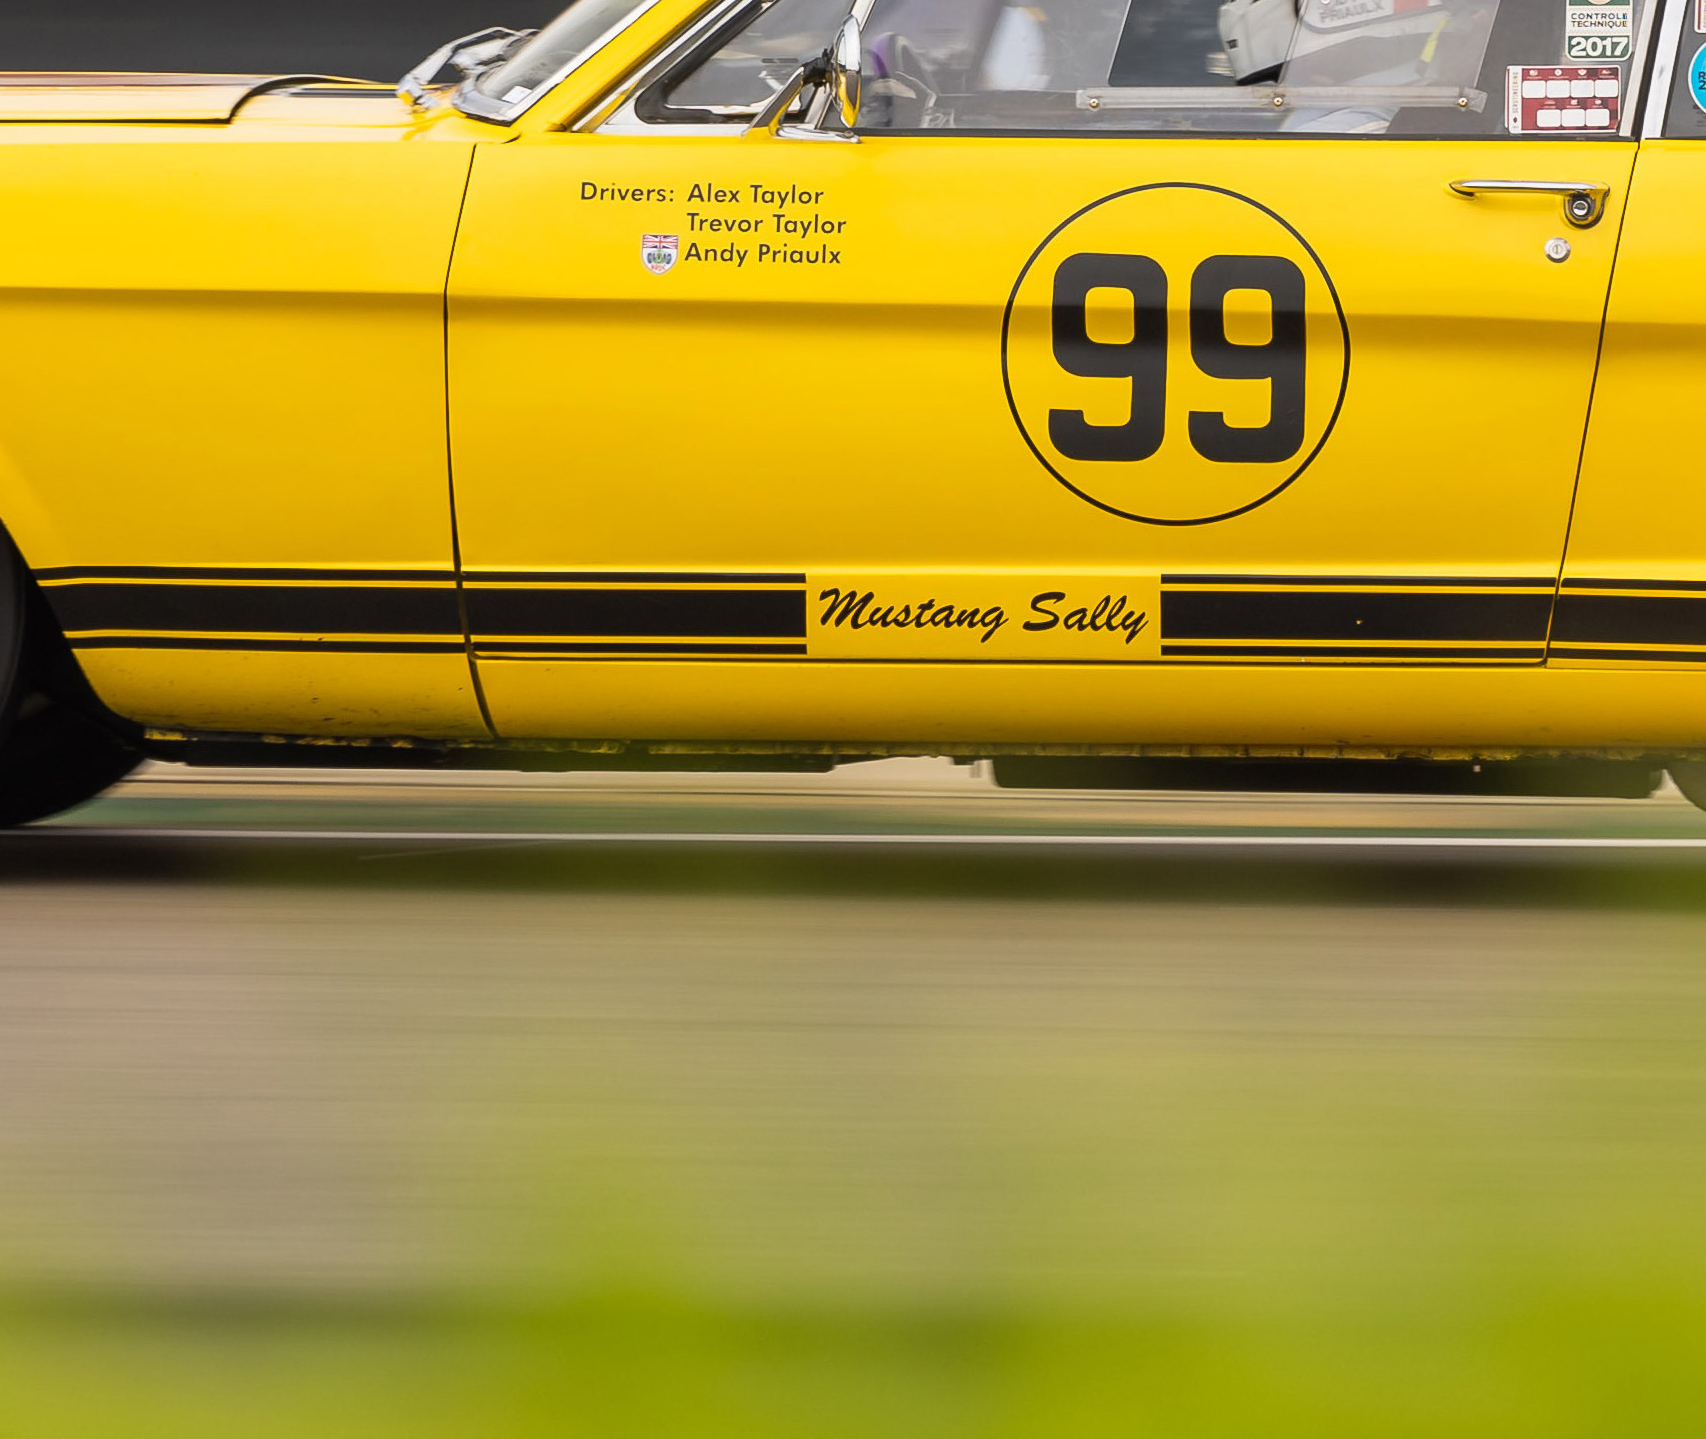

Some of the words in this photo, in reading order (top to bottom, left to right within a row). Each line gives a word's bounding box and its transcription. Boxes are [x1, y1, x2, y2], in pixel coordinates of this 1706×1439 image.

[1571, 12, 1628, 20] CONTROLE
[1571, 20, 1628, 29] TECHNIQUE
[1570, 36, 1629, 57] 2017
[580, 182, 674, 202] Drivers:
[686, 183, 741, 203] Alex
[750, 184, 824, 209] Taylor
[686, 212, 764, 232] Trevor
[772, 214, 847, 238] Taylor
[684, 242, 749, 267] Andy
[757, 243, 841, 264] Priaulx
[1048, 252, 1306, 463] 99
[818, 587, 1009, 644] Mustang
[1022, 591, 1149, 645] Sally
